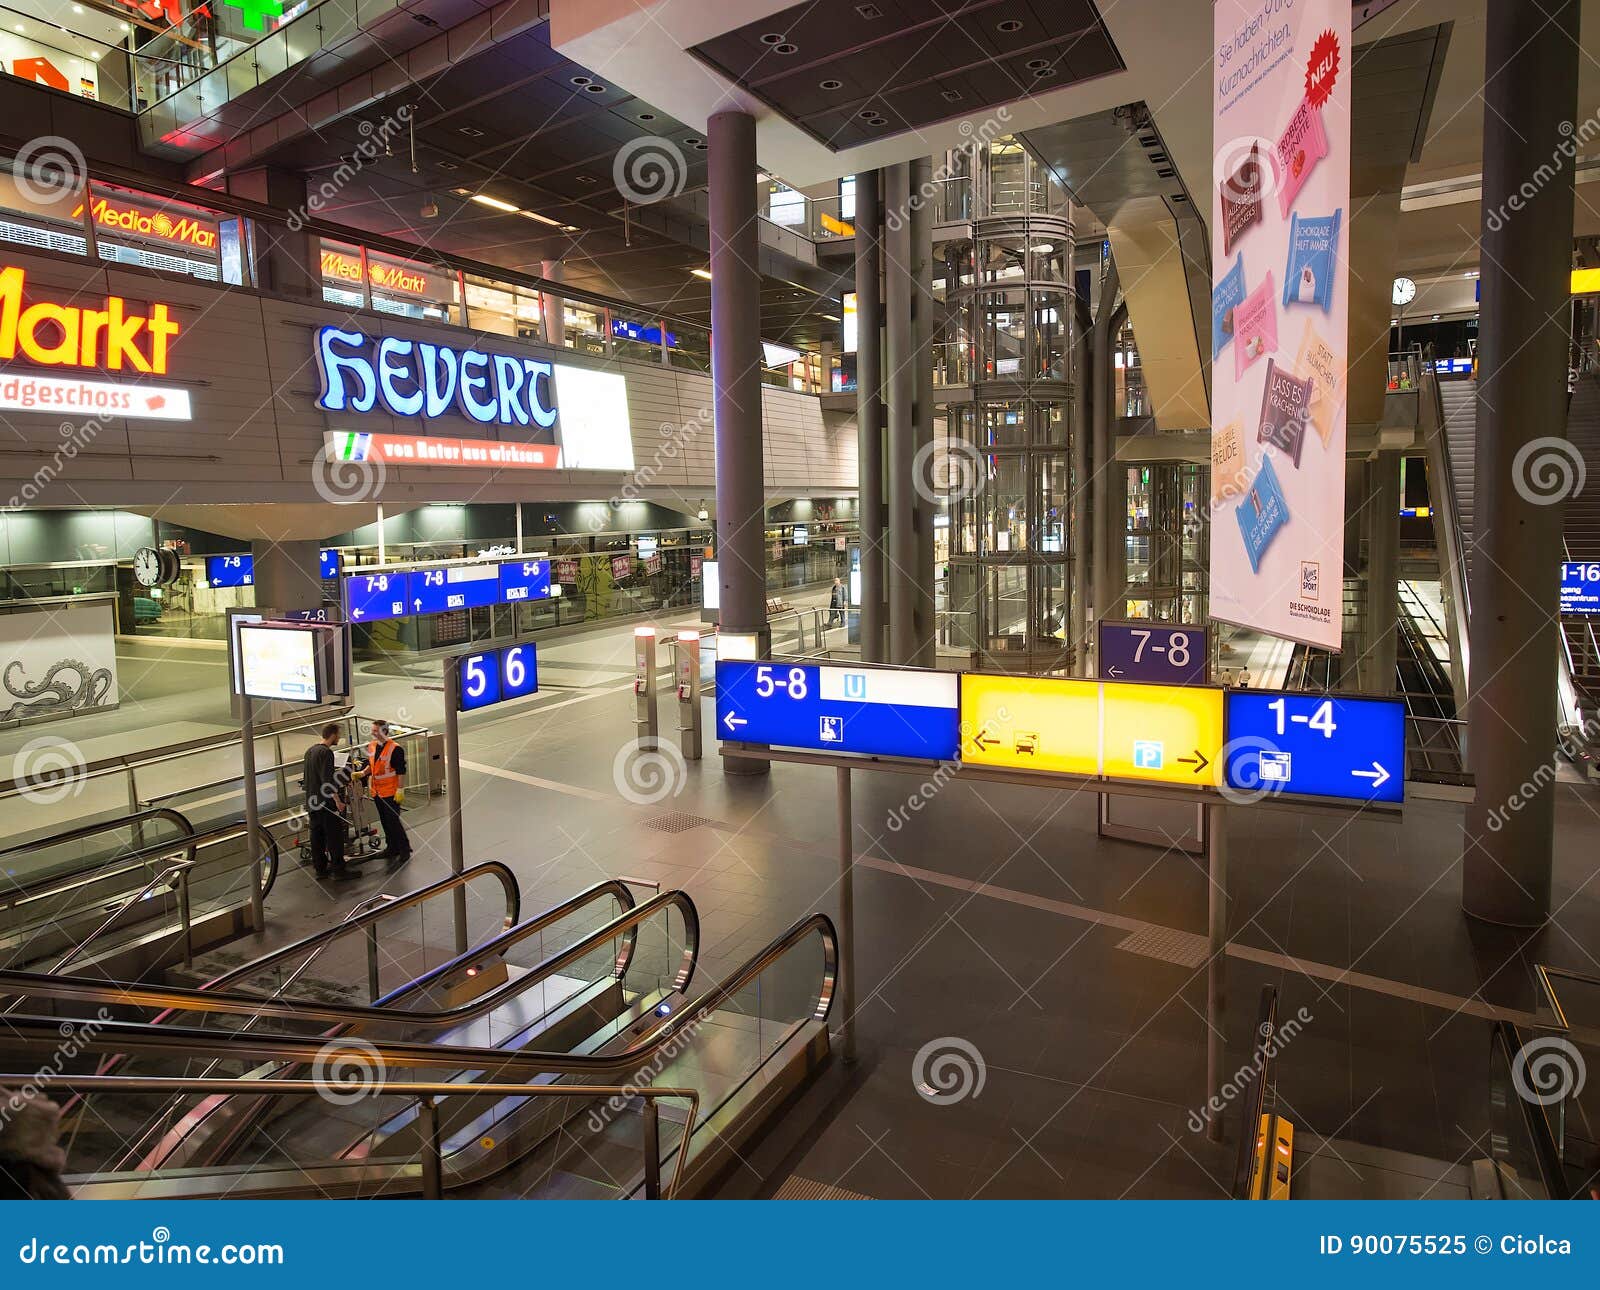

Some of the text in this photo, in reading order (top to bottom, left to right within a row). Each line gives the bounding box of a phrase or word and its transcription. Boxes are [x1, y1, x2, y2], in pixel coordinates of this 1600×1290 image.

[1219, 43, 1233, 68] Sie
[1234, 13, 1263, 53] haben
[1310, 51, 1334, 90] NEU
[1277, 103, 1307, 160] ERDBEER
[1280, 116, 1310, 171] SCHNITTE
[72, 196, 216, 249] Media Mar
[321, 254, 426, 293] Medi Markt
[0, 266, 180, 375] Markt
[1272, 374, 1303, 404] LASS ES
[383, 442, 414, 458] von
[416, 441, 461, 460] Natur
[223, 556, 241, 568] 7-8
[424, 571, 444, 587] 7-8
[523, 562, 540, 577] 5-6
[365, 575, 388, 592] 7-8
[1302, 581, 1317, 591] SPORT
[1289, 601, 1331, 617] DIE SCHOKOLADE
[1130, 629, 1190, 667] 7-8
[466, 655, 486, 697] 5
[506, 647, 525, 687] 6
[756, 666, 807, 699] 5-8
[846, 675, 862, 697] U
[1267, 697, 1337, 739] 1-4
[1142, 746, 1157, 767] P
